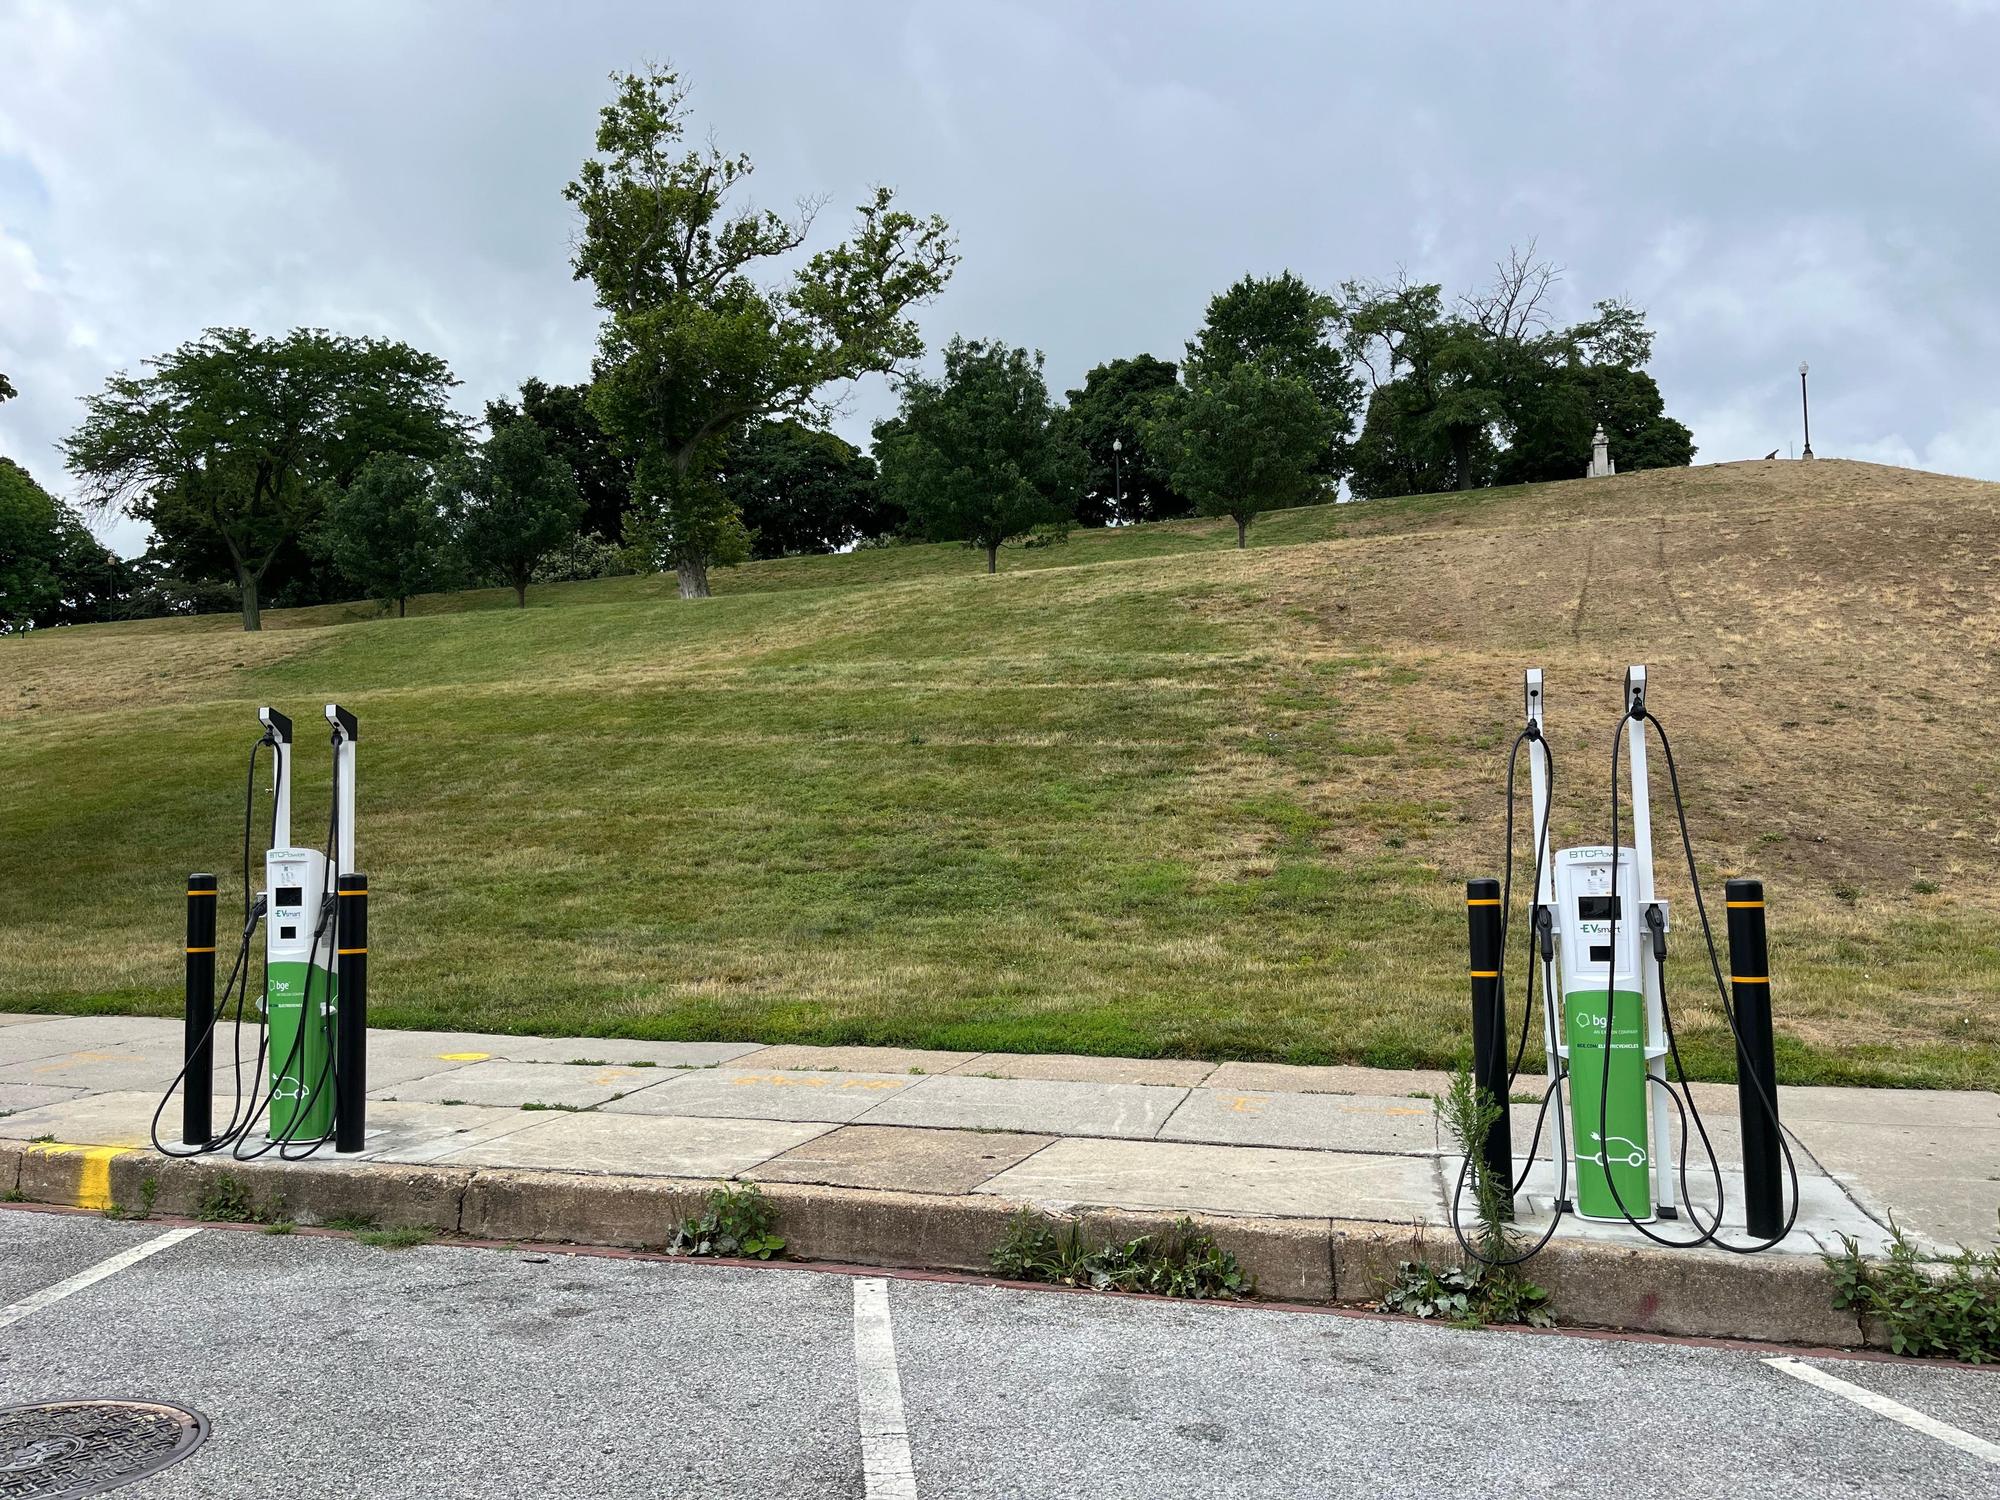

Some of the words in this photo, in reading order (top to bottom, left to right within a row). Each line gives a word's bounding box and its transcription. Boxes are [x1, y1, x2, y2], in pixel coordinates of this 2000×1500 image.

[1581, 924, 1621, 933] EVsmt
[276, 981, 289, 991] bge
[1592, 1014, 1614, 1029] bg
